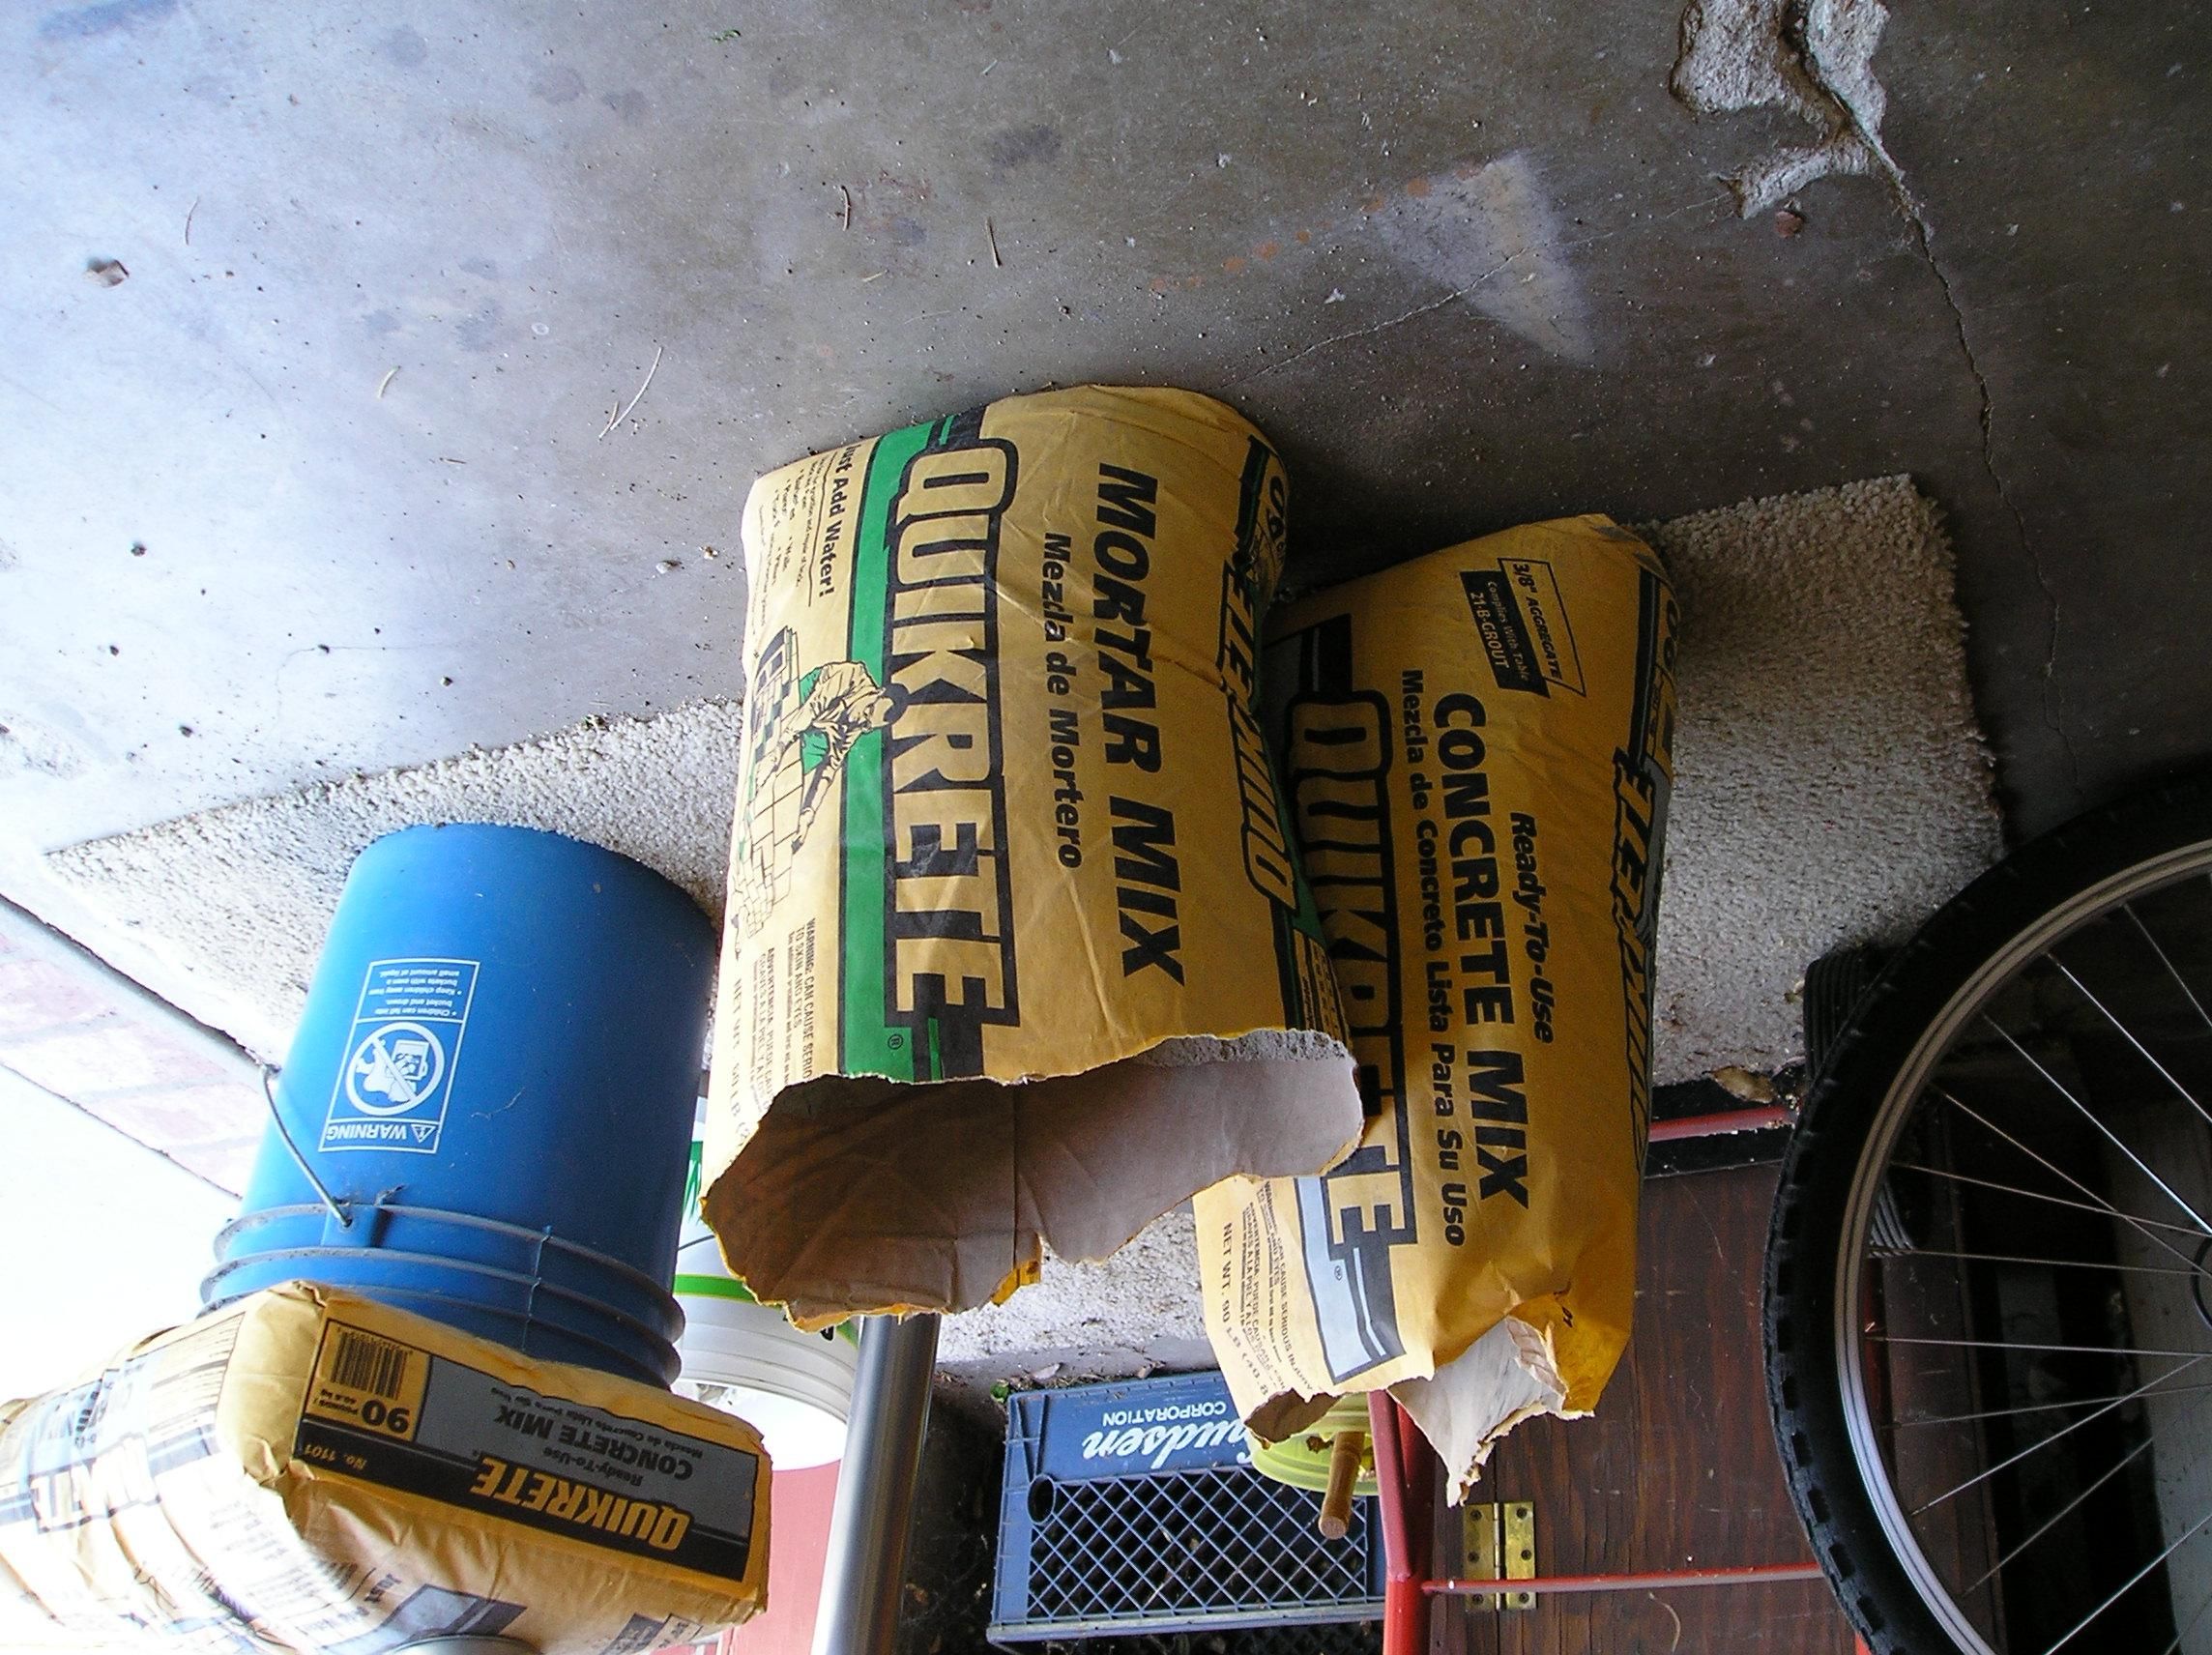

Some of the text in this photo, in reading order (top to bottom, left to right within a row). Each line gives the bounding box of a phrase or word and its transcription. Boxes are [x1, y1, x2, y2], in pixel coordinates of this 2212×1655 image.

[829, 478, 849, 517] Add
[819, 519, 843, 597] Water!
[1487, 581, 1530, 682] Complies With Table
[1512, 563, 1562, 681] 3/8" AGGREGATE
[1041, 531, 1085, 869] Mezcla de Mortero
[1092, 462, 1185, 988] MORTAR MIX
[890, 445, 1011, 1016] QUIKRETE
[1433, 691, 1530, 1209] CONCRETE MIX
[1509, 810, 1556, 1045] Ready-To-Use
[793, 925, 804, 1029] TO SKIN AND EYES
[1401, 669, 1466, 1247] Mezcla de Concreto Lista Para Su Uso
[803, 976, 814, 1000] CAN
[802, 1002, 813, 1038] CAUSE
[326, 1124, 407, 1141] WARNING
[1222, 1223, 1233, 1255] NET
[1220, 1260, 1233, 1294] WT.
[1221, 1299, 1230, 1322] 90
[1281, 1301, 1292, 1352] SERIOUS
[361, 1399, 411, 1435] 90
[1103, 1401, 1227, 1427] CORPORATION
[304, 1443, 367, 1470] No. 1101
[493, 1405, 693, 1481] CONCRETE MIX
[542, 1446, 644, 1487] Ready-To-Use
[1082, 1418, 1252, 1469] nudsen
[470, 1456, 692, 1551] QUIKRETE
